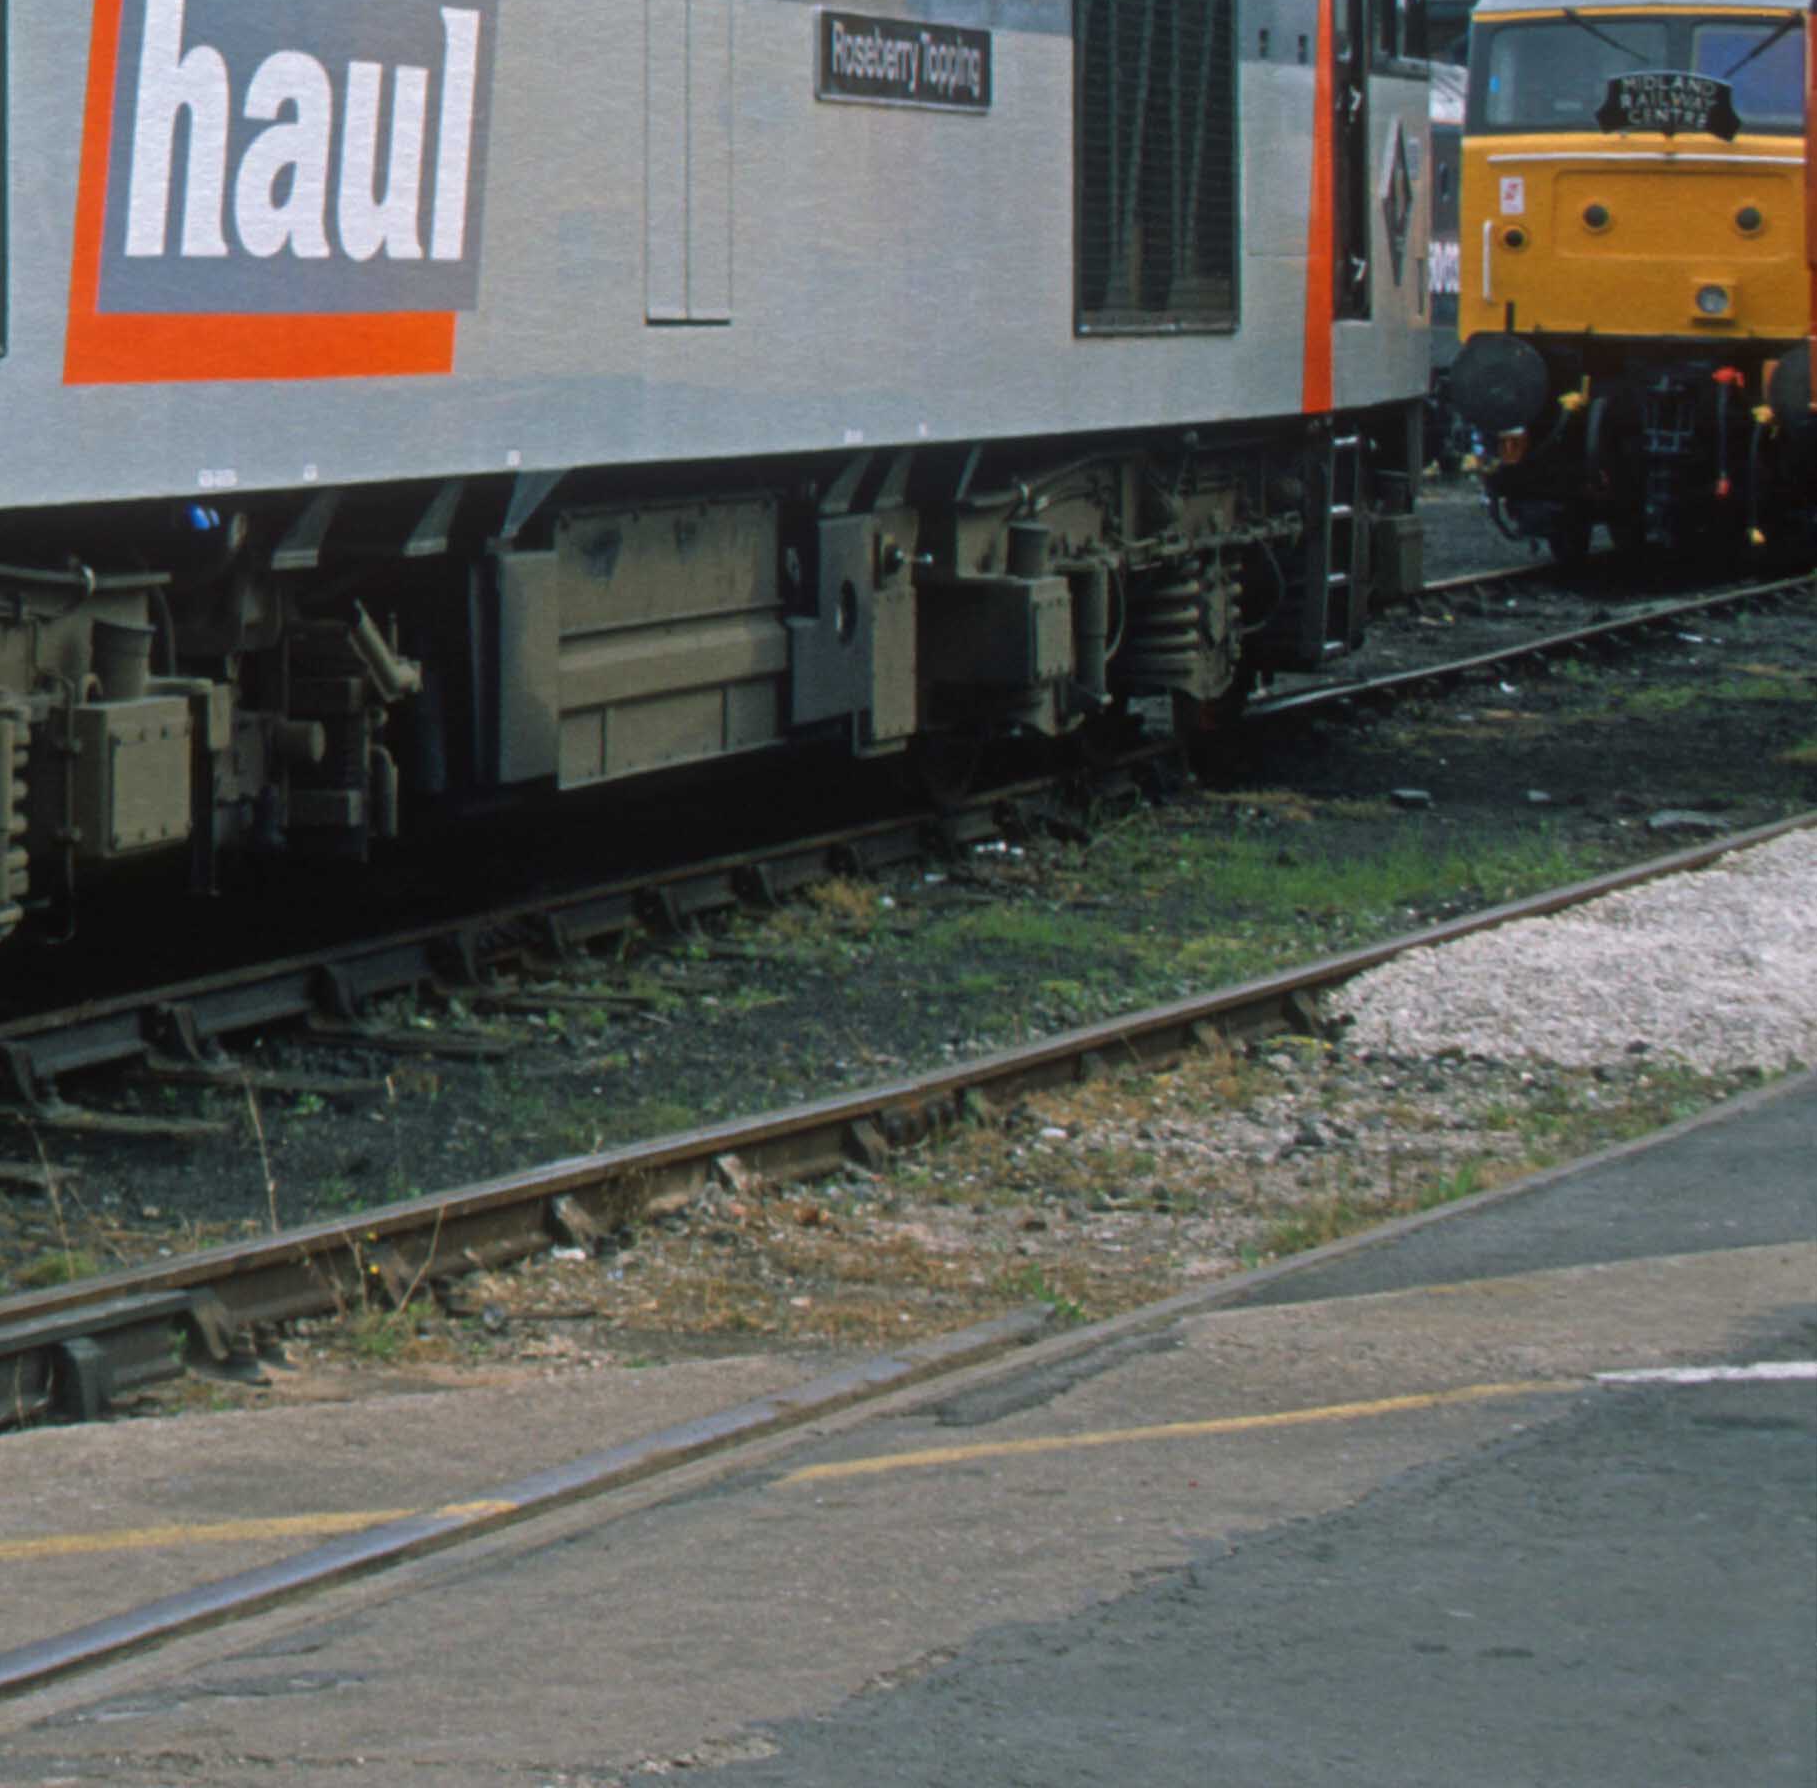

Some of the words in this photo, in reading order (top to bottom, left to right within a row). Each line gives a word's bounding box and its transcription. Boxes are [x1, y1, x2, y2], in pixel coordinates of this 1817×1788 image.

[832, 20, 918, 92] Roseberry
[921, 31, 981, 99] Topping
[1621, 75, 1717, 96] MIDLAND
[1620, 91, 1718, 111] RAILWAY
[1628, 107, 1708, 129] CENTRE
